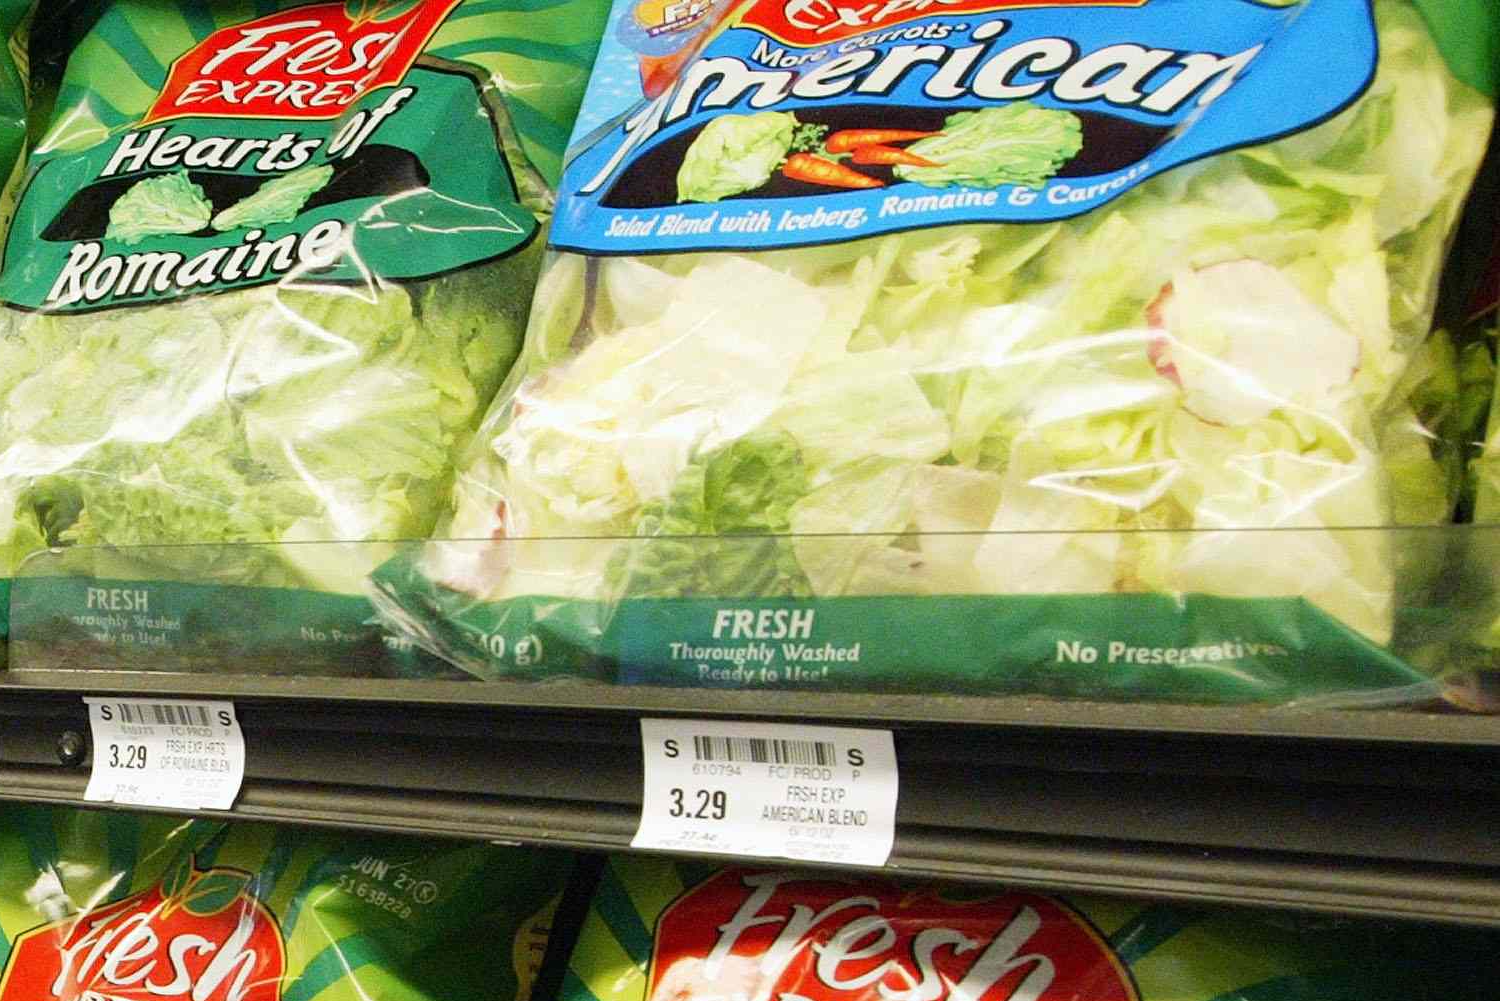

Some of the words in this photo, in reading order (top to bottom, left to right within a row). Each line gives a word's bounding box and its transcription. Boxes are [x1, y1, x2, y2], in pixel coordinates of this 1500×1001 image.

[752, 38, 827, 69] More
[580, 18, 1265, 193] merican
[100, 128, 322, 178] Hearts
[326, 86, 412, 157] of
[604, 214, 653, 238] Salad
[655, 211, 716, 237] Blend
[719, 209, 772, 234] with
[879, 186, 997, 219] Romaine
[1008, 186, 1037, 206] &
[1046, 162, 1150, 206] Carrots
[46, 219, 346, 305] Romaine
[86, 586, 149, 612] FRESH
[711, 608, 816, 639] FRESH
[669, 641, 776, 665] Thoroughly
[781, 641, 861, 663] Washed
[1056, 640, 1098, 665] No
[696, 664, 754, 683] Ready
[759, 666, 779, 682] to
[100, 704, 113, 721] S
[217, 710, 232, 727] S
[108, 743, 148, 769] 3.29
[663, 739, 680, 759] S
[846, 747, 865, 767] S
[792, 765, 833, 782] PROD
[669, 788, 728, 820] 3.29
[786, 785, 818, 802] FRSH
[820, 786, 846, 803] EXP
[761, 804, 825, 825] AMERICAN
[827, 807, 869, 827] BLEND
[351, 855, 389, 881] JUN
